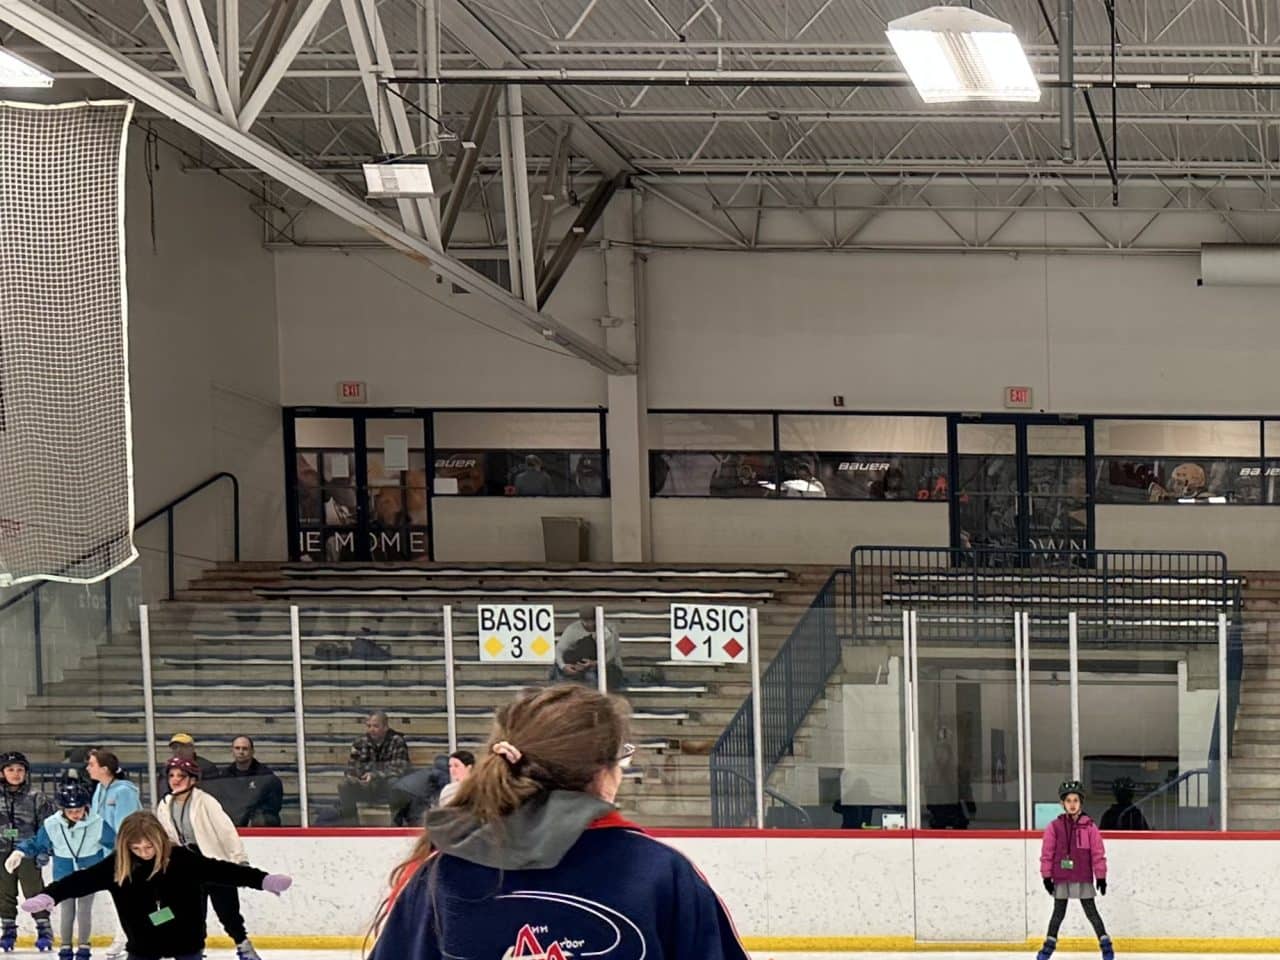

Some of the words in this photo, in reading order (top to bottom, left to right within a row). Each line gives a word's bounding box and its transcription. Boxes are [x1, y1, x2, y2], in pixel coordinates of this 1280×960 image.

[343, 383, 360, 397] EXIT
[434, 459, 476, 468] AUER
[838, 462, 890, 471] BAUER
[480, 607, 551, 632] BASIC
[673, 606, 745, 633] BASIC
[510, 635, 523, 659] 3
[702, 635, 712, 659] 1
